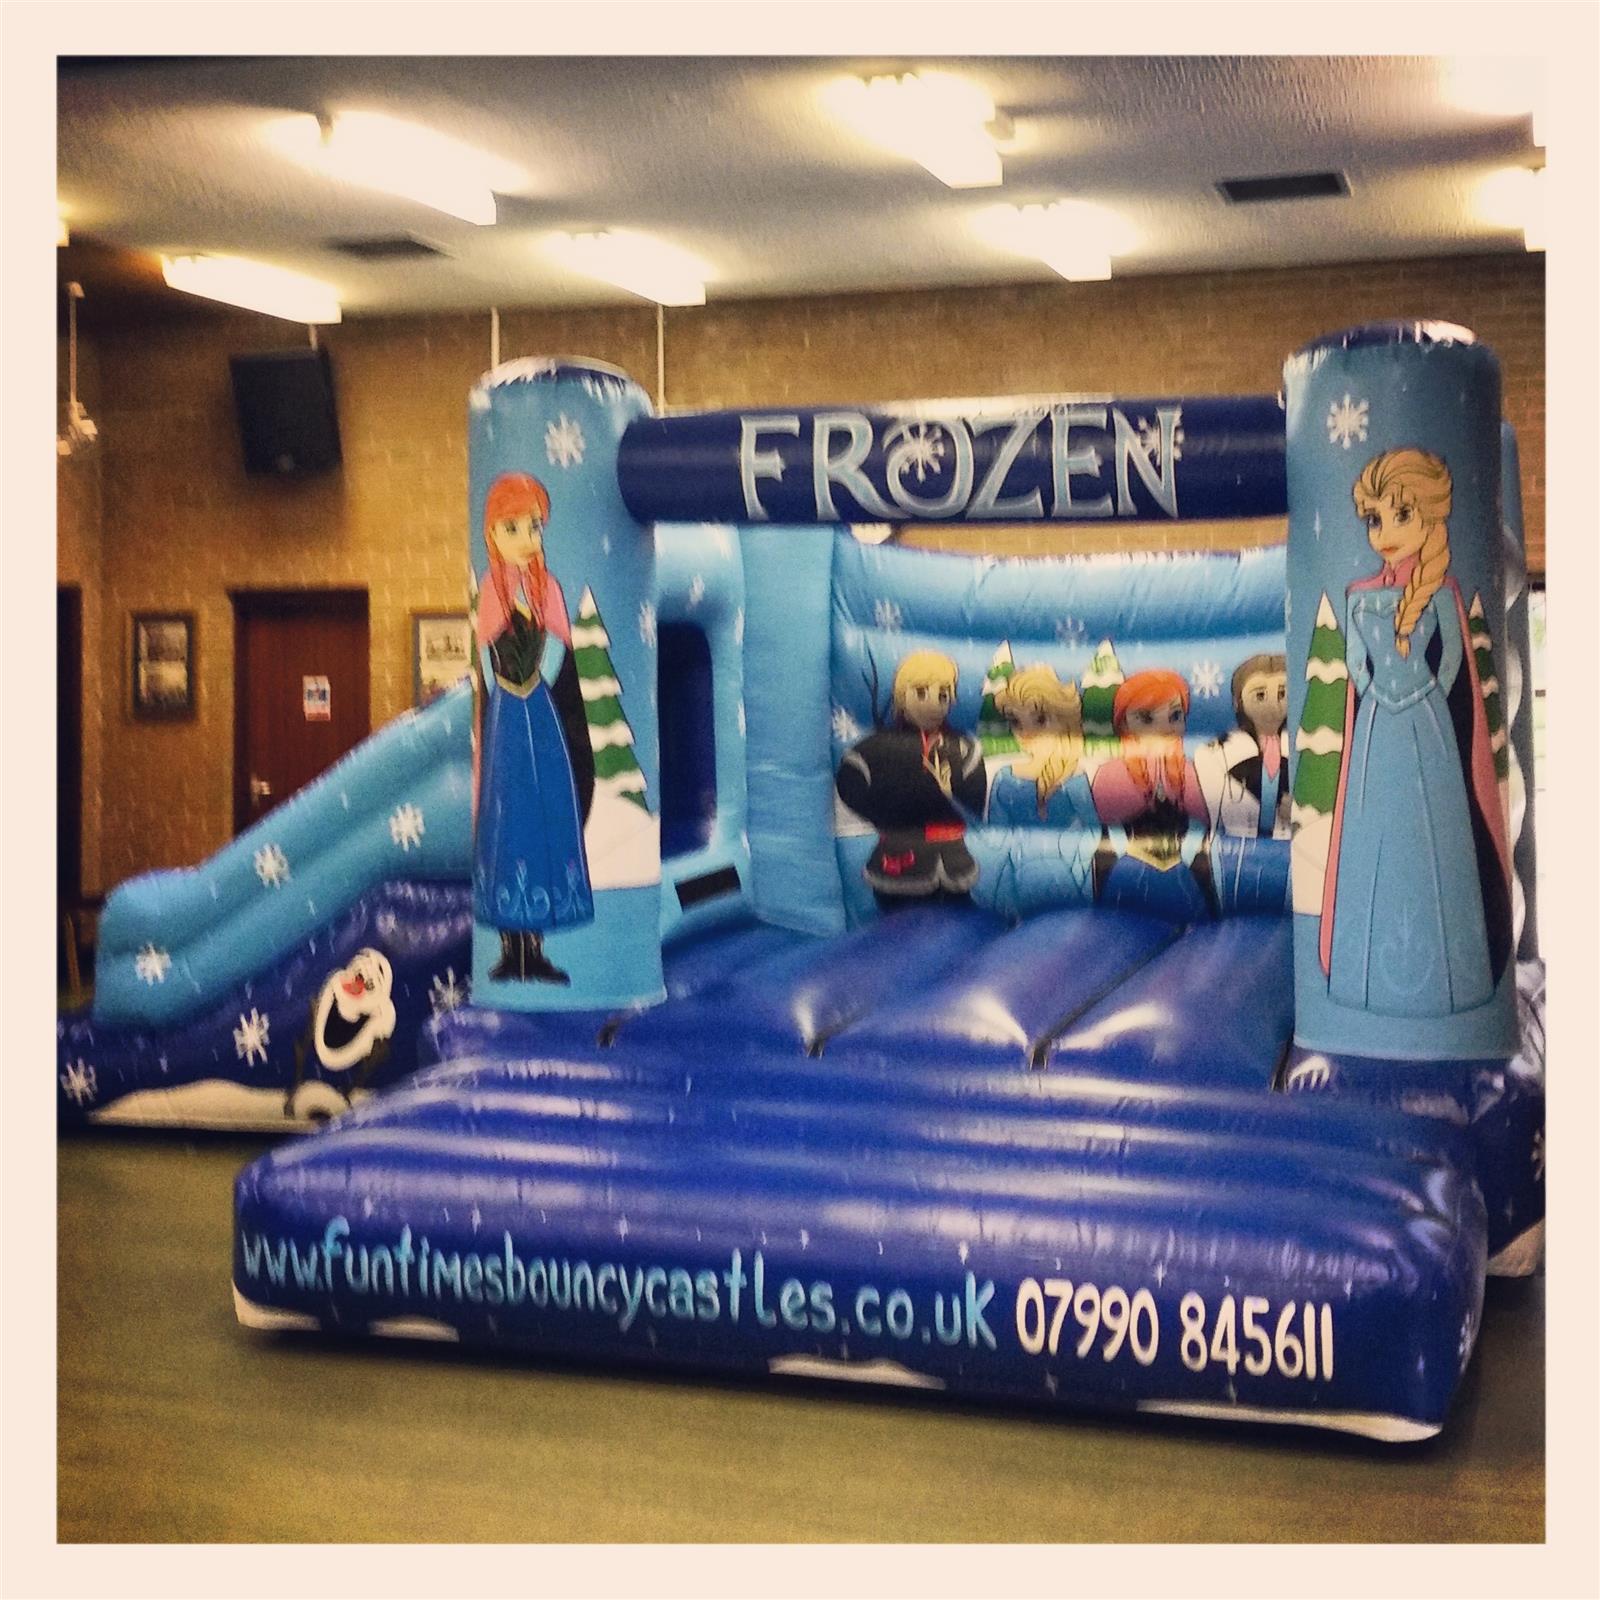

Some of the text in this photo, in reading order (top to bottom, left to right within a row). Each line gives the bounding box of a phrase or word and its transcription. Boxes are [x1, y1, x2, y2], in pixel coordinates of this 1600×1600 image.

[740, 405, 1183, 521] FROZEN
[1015, 1278, 1160, 1366] 07990
[1180, 1291, 1334, 1381] 845611
